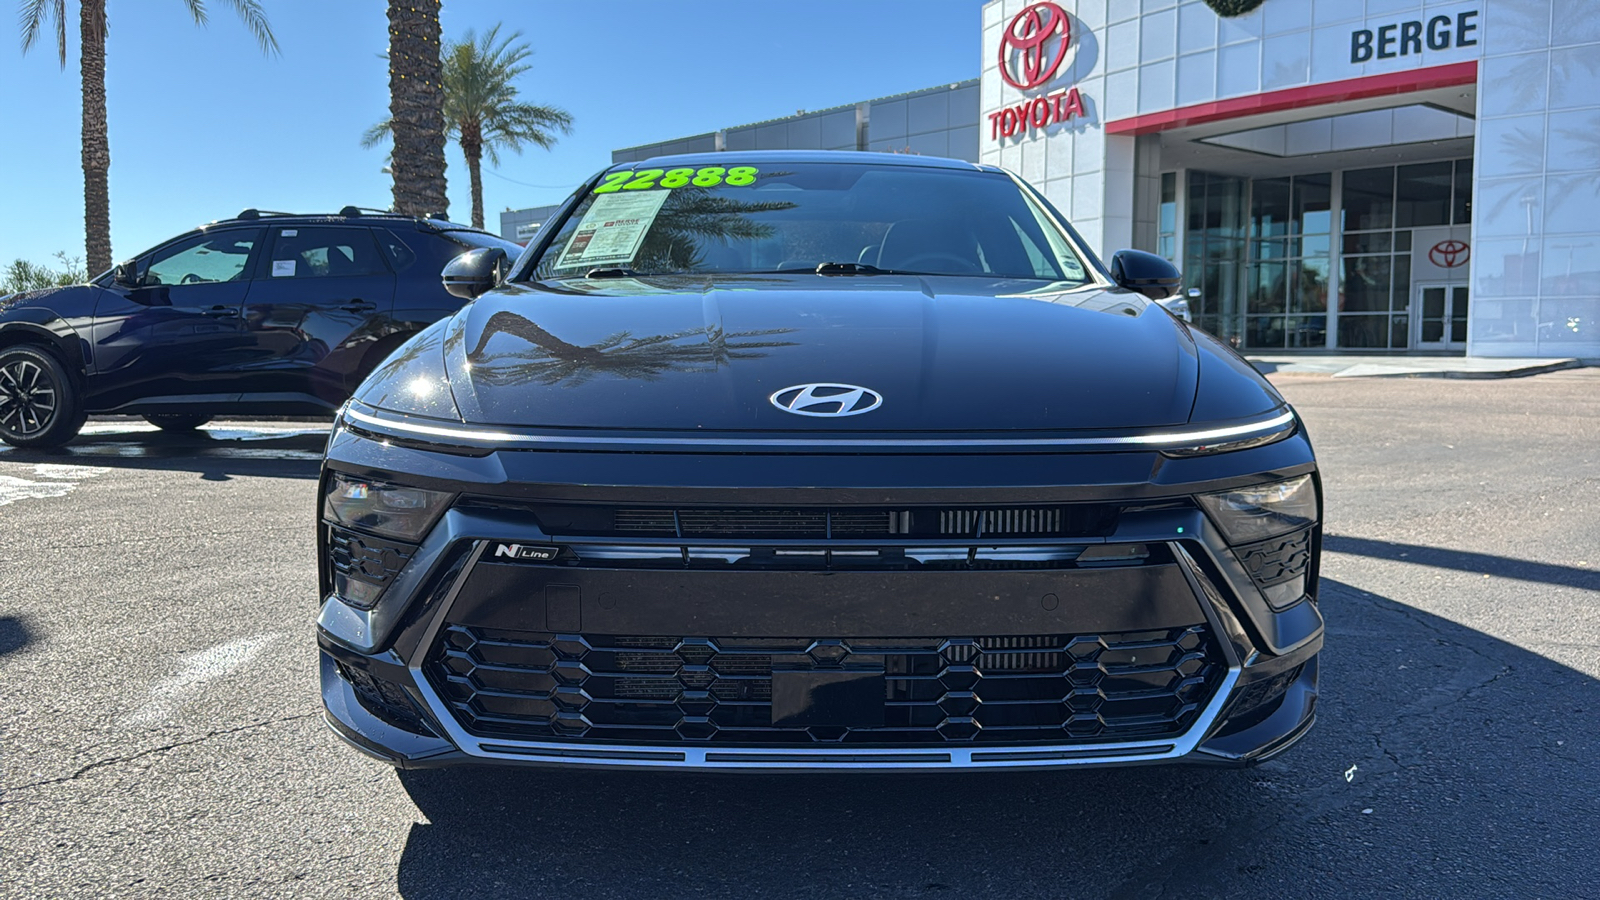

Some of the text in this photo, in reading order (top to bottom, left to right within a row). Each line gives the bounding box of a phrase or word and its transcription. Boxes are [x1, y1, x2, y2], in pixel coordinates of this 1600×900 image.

[1350, 10, 1478, 64] BERGE
[988, 88, 1084, 141] TOYOTA
[593, 166, 758, 194] 22888
[494, 544, 549, 558] N Line
